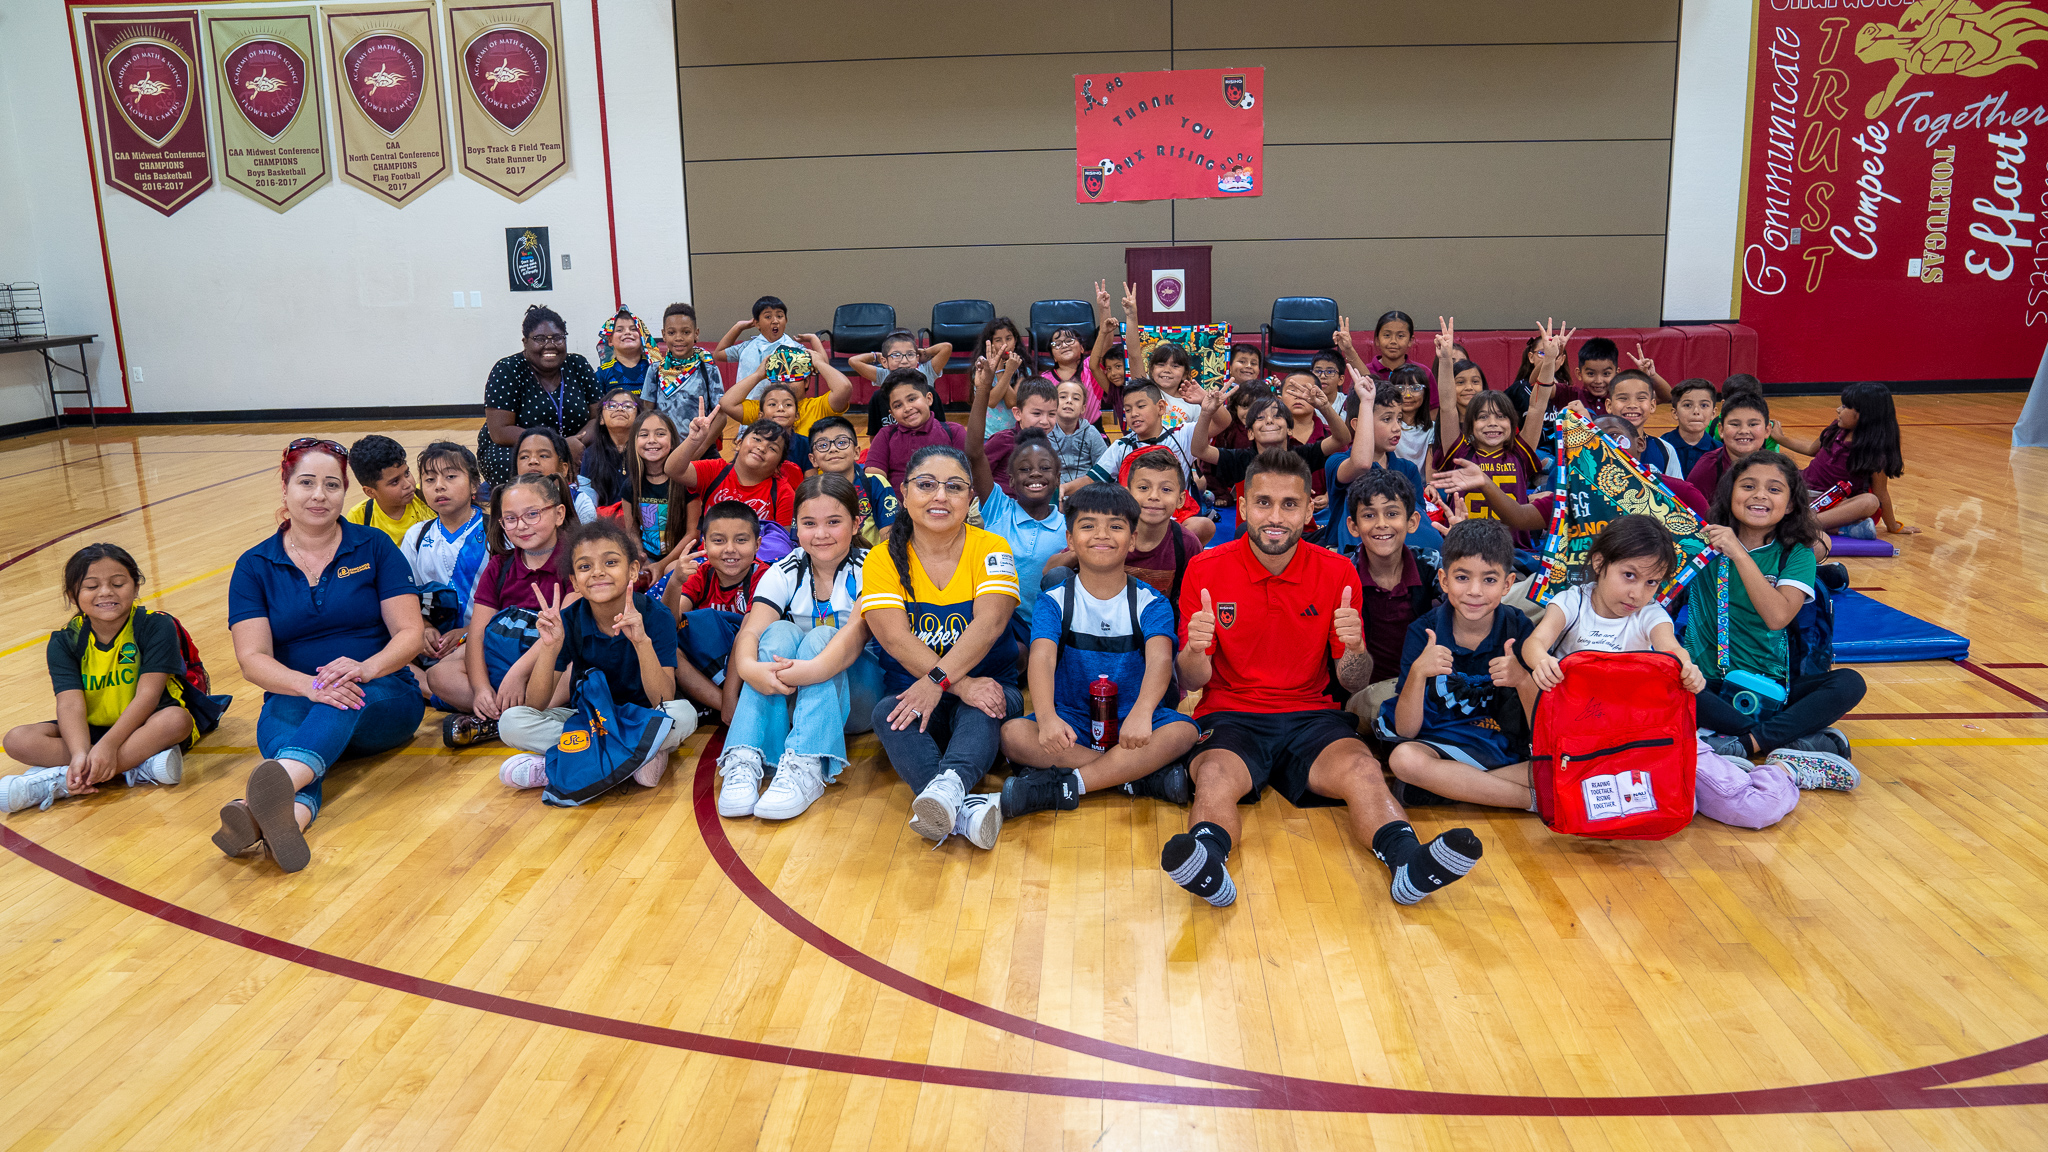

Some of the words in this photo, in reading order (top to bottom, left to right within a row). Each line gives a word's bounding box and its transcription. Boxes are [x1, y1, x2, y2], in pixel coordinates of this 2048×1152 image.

[354, 50, 367, 81] ACADEMY
[402, 52, 417, 78] SCIENCE
[474, 47, 489, 77] ACADEMY
[489, 40, 498, 48] OF
[525, 47, 540, 74] SCIENCE
[119, 58, 132, 88] ACADEMY
[141, 52, 160, 60] MATH
[166, 61, 182, 88] SCIENCE
[234, 56, 248, 86] ACADEMY
[258, 49, 276, 57] MATH
[283, 58, 298, 84] SCIENCE
[1106, 77, 1124, 93] #8
[361, 95, 387, 113] FLOWER
[390, 91, 415, 113] CAMPUS
[482, 90, 508, 109] FLOWER
[511, 87, 538, 109] CAMPUS
[126, 102, 153, 121] FLOWER
[156, 100, 180, 121] CAMPUS
[242, 99, 269, 118] FLOWER
[271, 97, 296, 117] CAMPUS
[1113, 94, 1174, 127] THANK
[1895, 91, 2048, 148] Together
[1181, 117, 1213, 140] YOU
[246, 148, 276, 156] Midwest
[386, 142, 400, 150] CAA
[467, 146, 485, 155] Boys
[487, 145, 510, 153] Track
[518, 143, 539, 151] Field
[541, 142, 561, 150] Team
[115, 152, 130, 160] CAA
[132, 151, 162, 159] Midwest
[254, 158, 298, 166] CHAMPIONS
[349, 154, 369, 162] North
[370, 153, 397, 161] Central
[399, 150, 439, 159] Conference
[486, 156, 505, 164] State
[537, 155, 546, 163] Up
[1115, 150, 1145, 174] PHX
[1157, 145, 1215, 170] RISING
[1744, 26, 1800, 295] Communicate
[1798, 17, 1850, 293] TRUST
[140, 161, 184, 170] CHAMPIONS
[247, 169, 265, 177] Boys
[267, 168, 306, 176] Basketball
[373, 162, 417, 171] CHAMPIONS
[134, 172, 151, 180] Girls
[256, 178, 297, 186] 2016-2017
[373, 174, 389, 182] Flag
[391, 172, 420, 180] Football
[142, 182, 184, 190] 2016-2017
[1830, 121, 1901, 260] Compete
[1965, 129, 2035, 281] Effort
[1921, 145, 1955, 283] TORTUGAS
[1496, 463, 1516, 472] STATE
[1201, 876, 1212, 888] LG
[1428, 874, 1442, 885] LG
